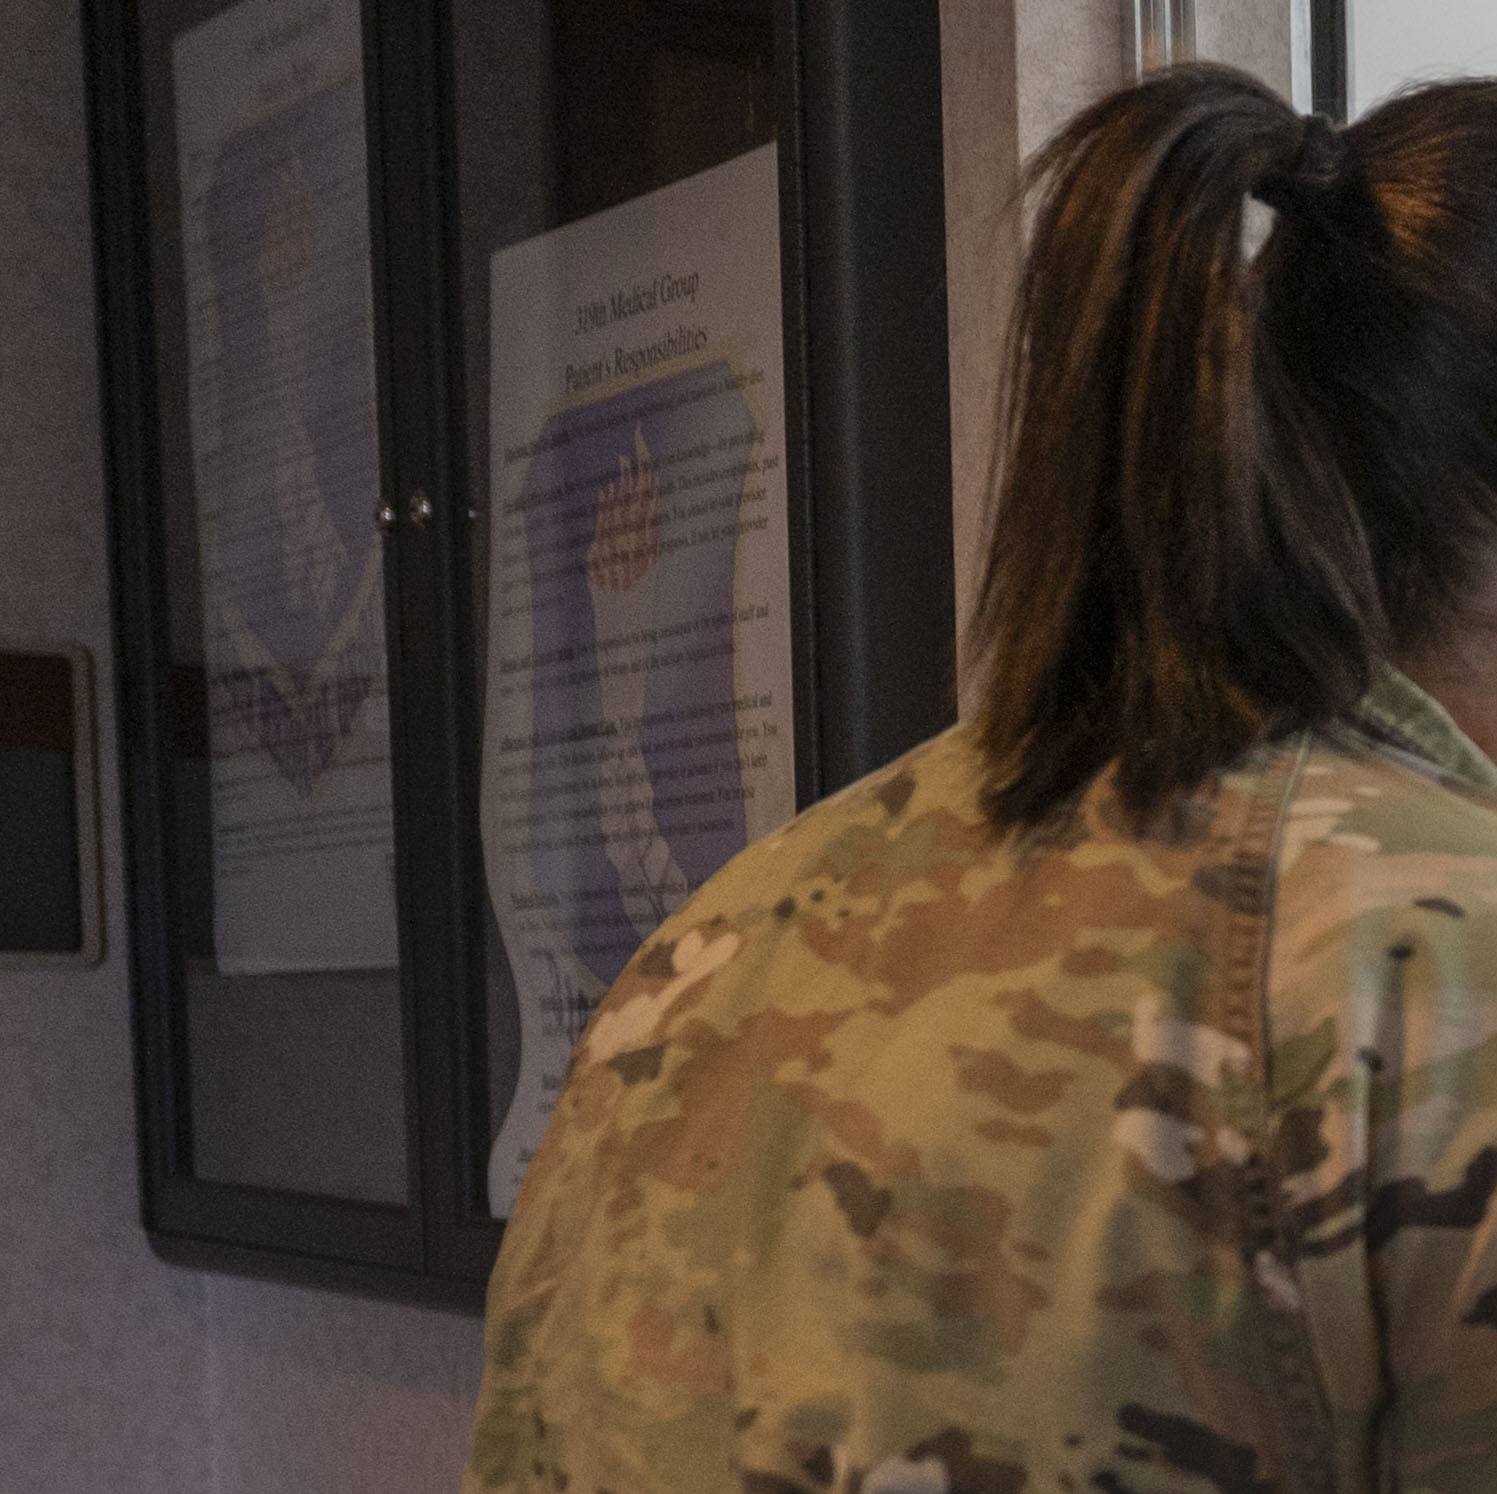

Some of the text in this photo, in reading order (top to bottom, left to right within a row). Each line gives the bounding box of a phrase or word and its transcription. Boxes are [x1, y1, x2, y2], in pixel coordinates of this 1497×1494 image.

[610, 278, 657, 320] Medical
[660, 272, 700, 303] Group
[615, 324, 708, 378] Responsibilities
